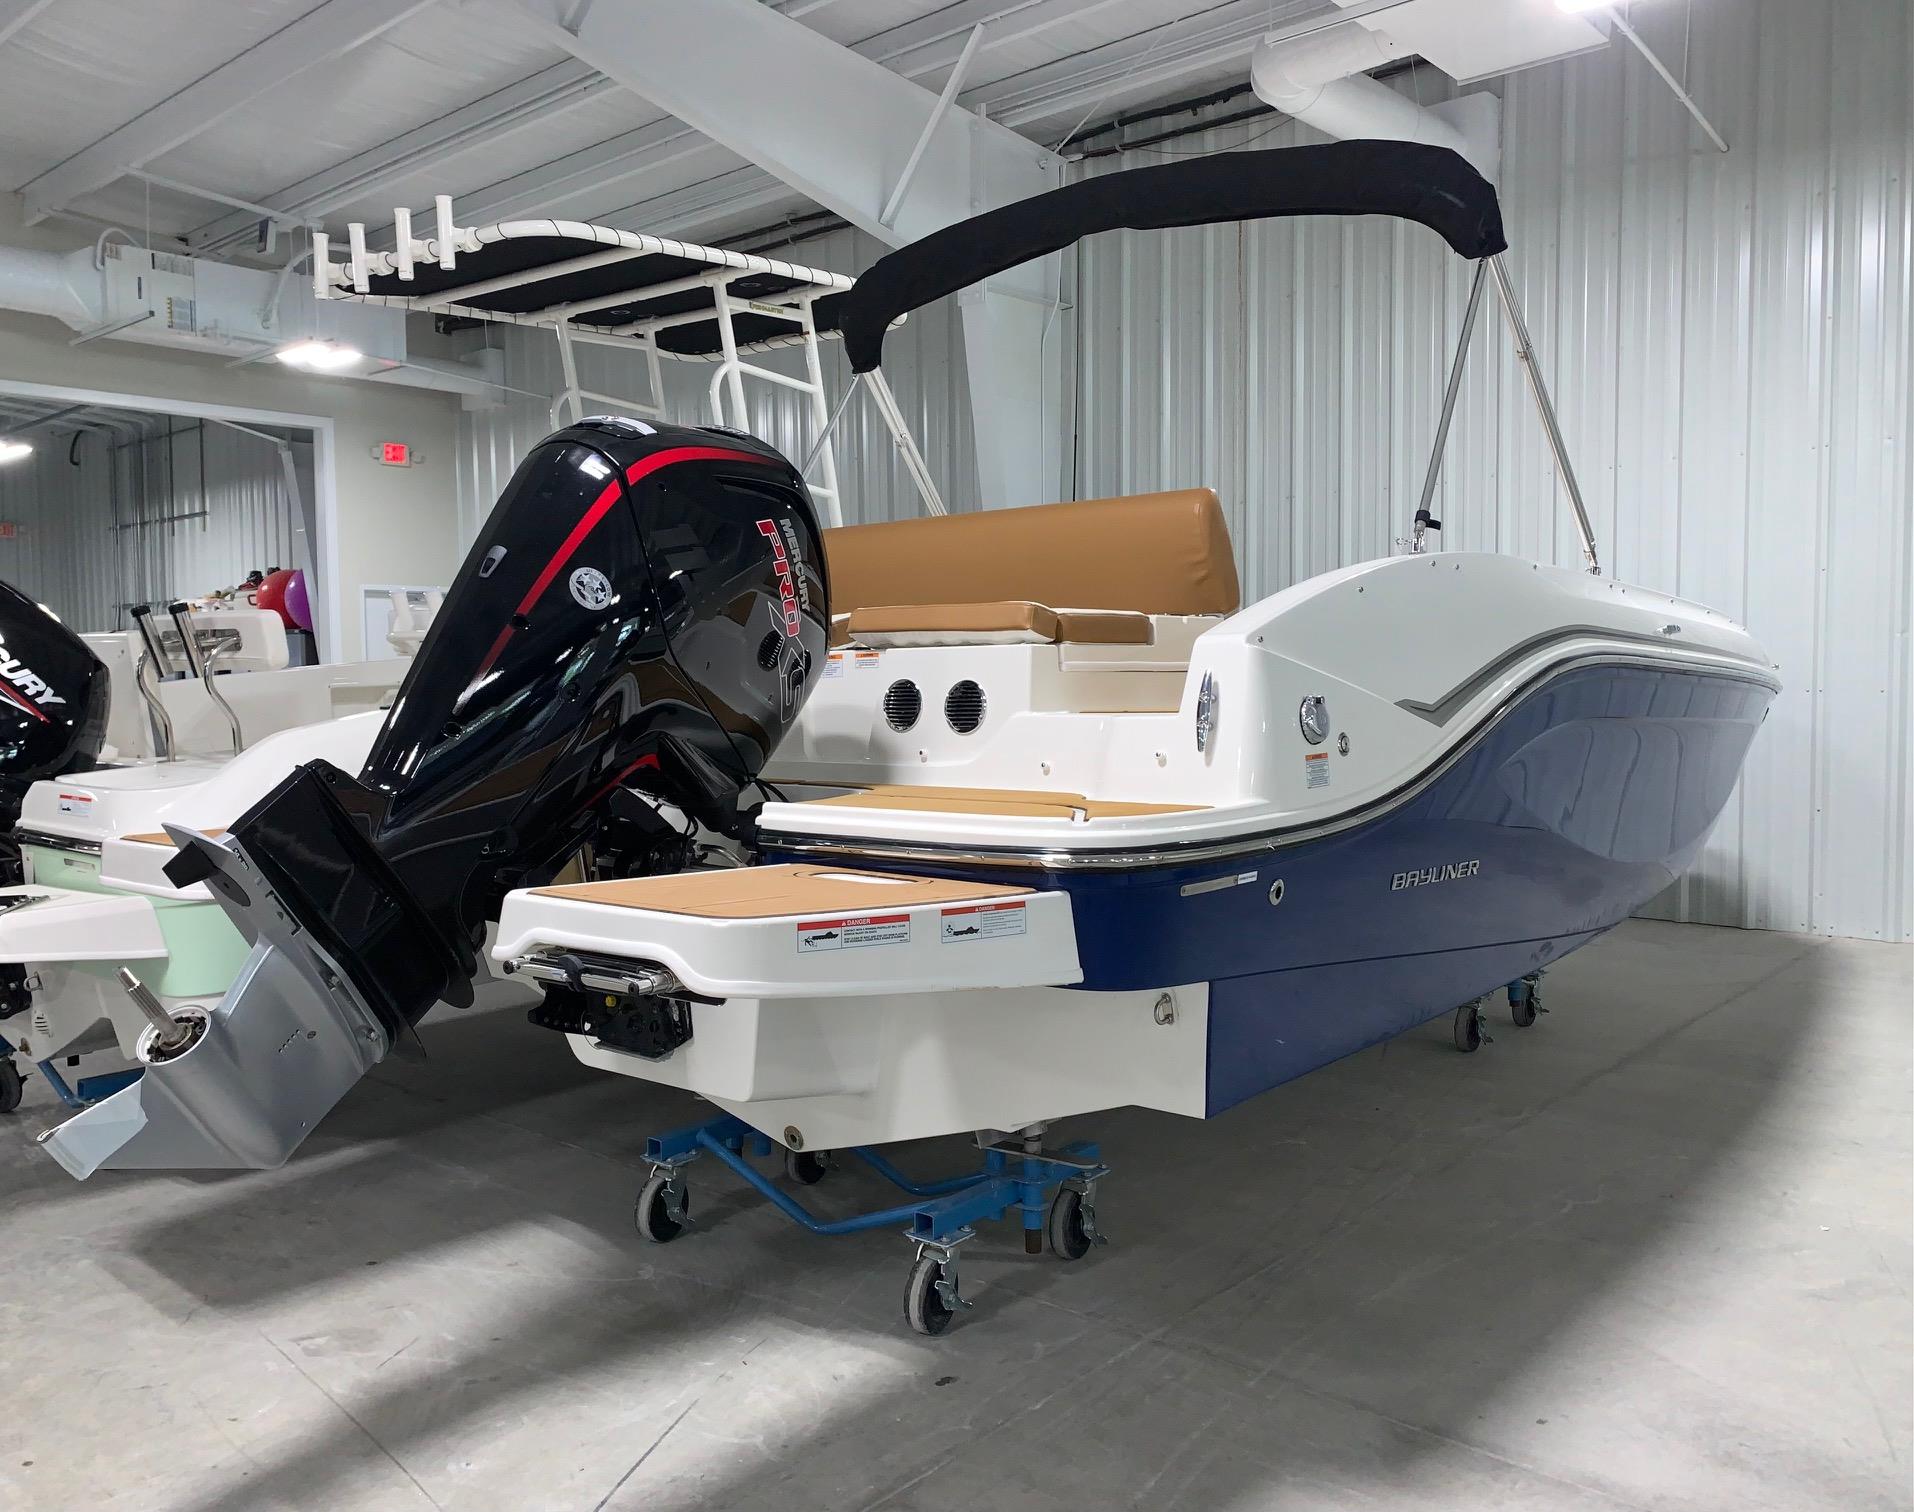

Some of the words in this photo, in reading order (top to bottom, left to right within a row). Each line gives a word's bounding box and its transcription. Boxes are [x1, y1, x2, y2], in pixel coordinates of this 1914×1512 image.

[756, 518, 801, 638] PRO
[779, 518, 811, 613] MERCURY
[1390, 859, 1480, 891] BAYLINER
[846, 917, 871, 926] DANGER
